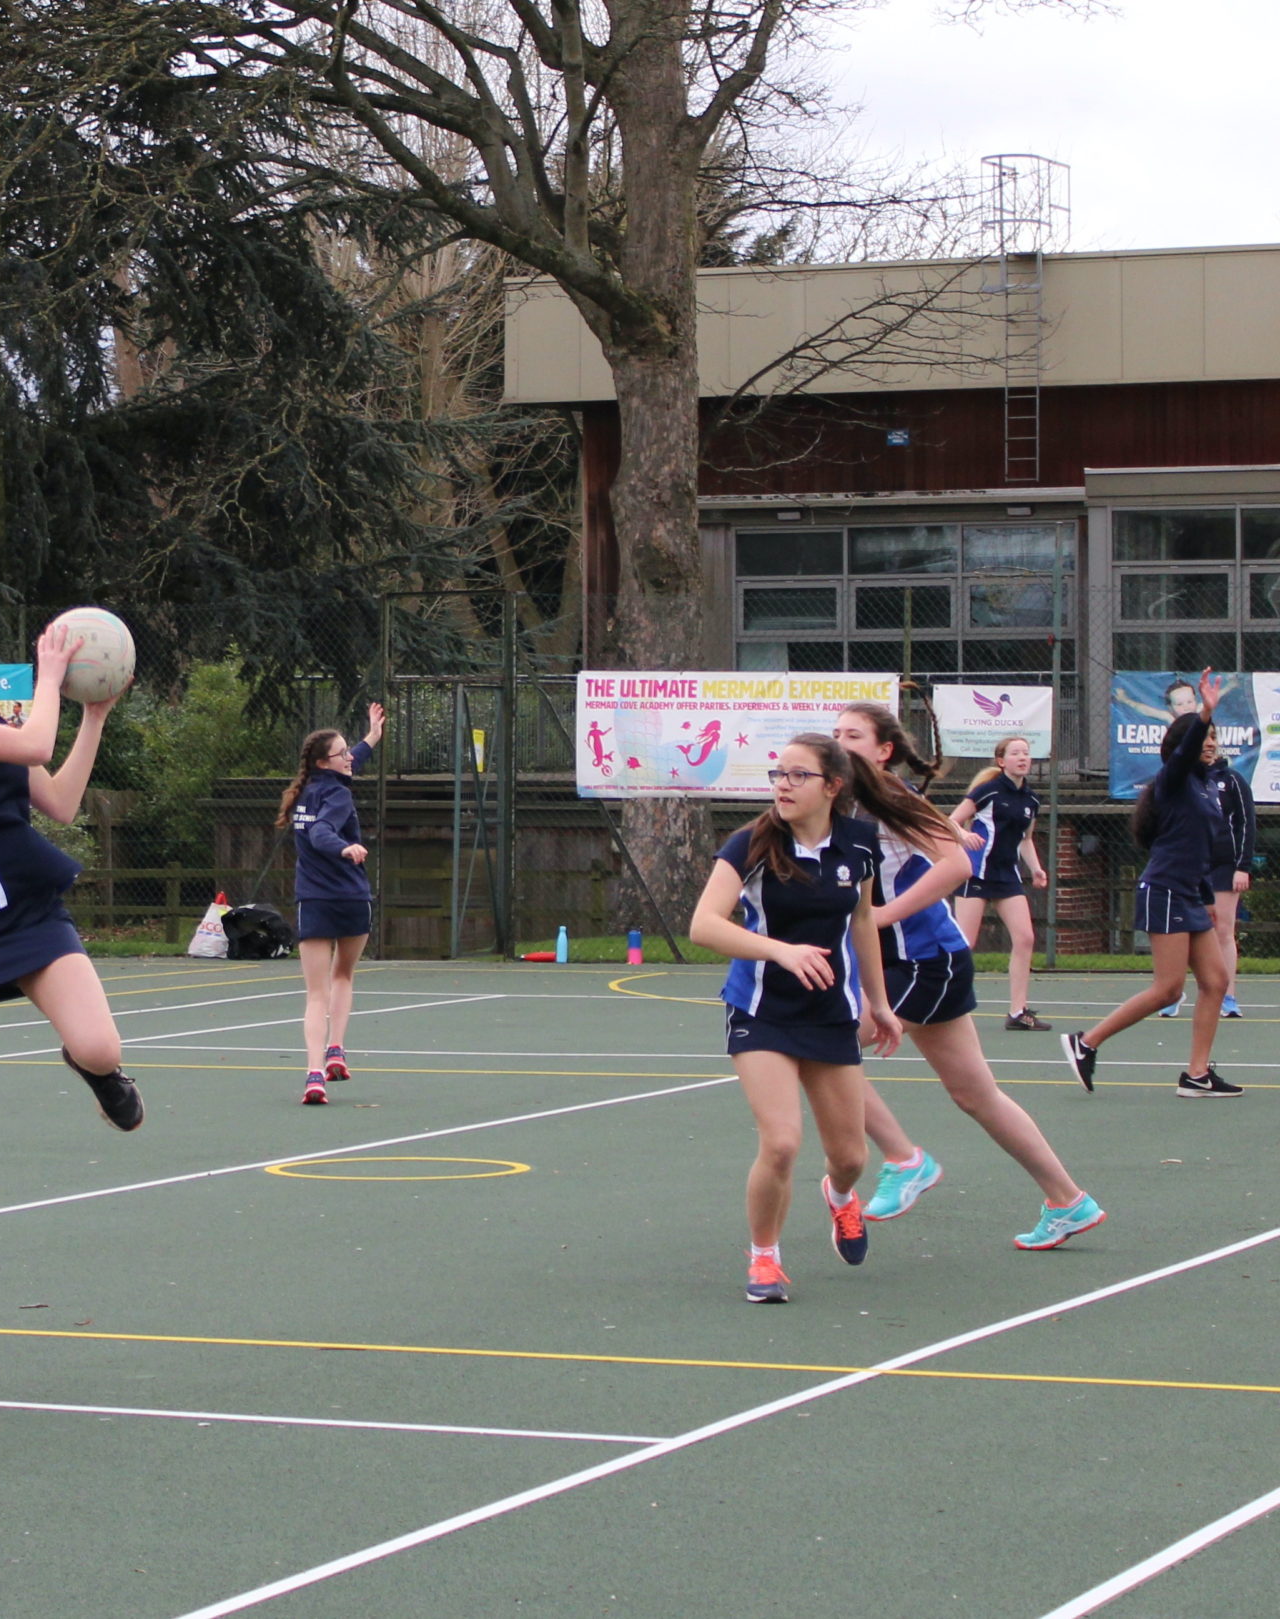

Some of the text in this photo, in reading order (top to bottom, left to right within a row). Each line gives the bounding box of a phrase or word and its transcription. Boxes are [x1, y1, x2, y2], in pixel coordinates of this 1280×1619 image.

[586, 679, 892, 700] THE ULTIMATE MERMAID EXPERIENCE
[586, 701, 619, 710] MERMAID
[620, 702, 638, 710] COVE
[640, 702, 675, 710] ACADEMY
[676, 702, 697, 710] OFFER
[734, 702, 780, 711] EXPERIENCES
[783, 703, 789, 711] &
[792, 703, 820, 711] WEEKLY
[1216, 726, 1254, 746] WIM
